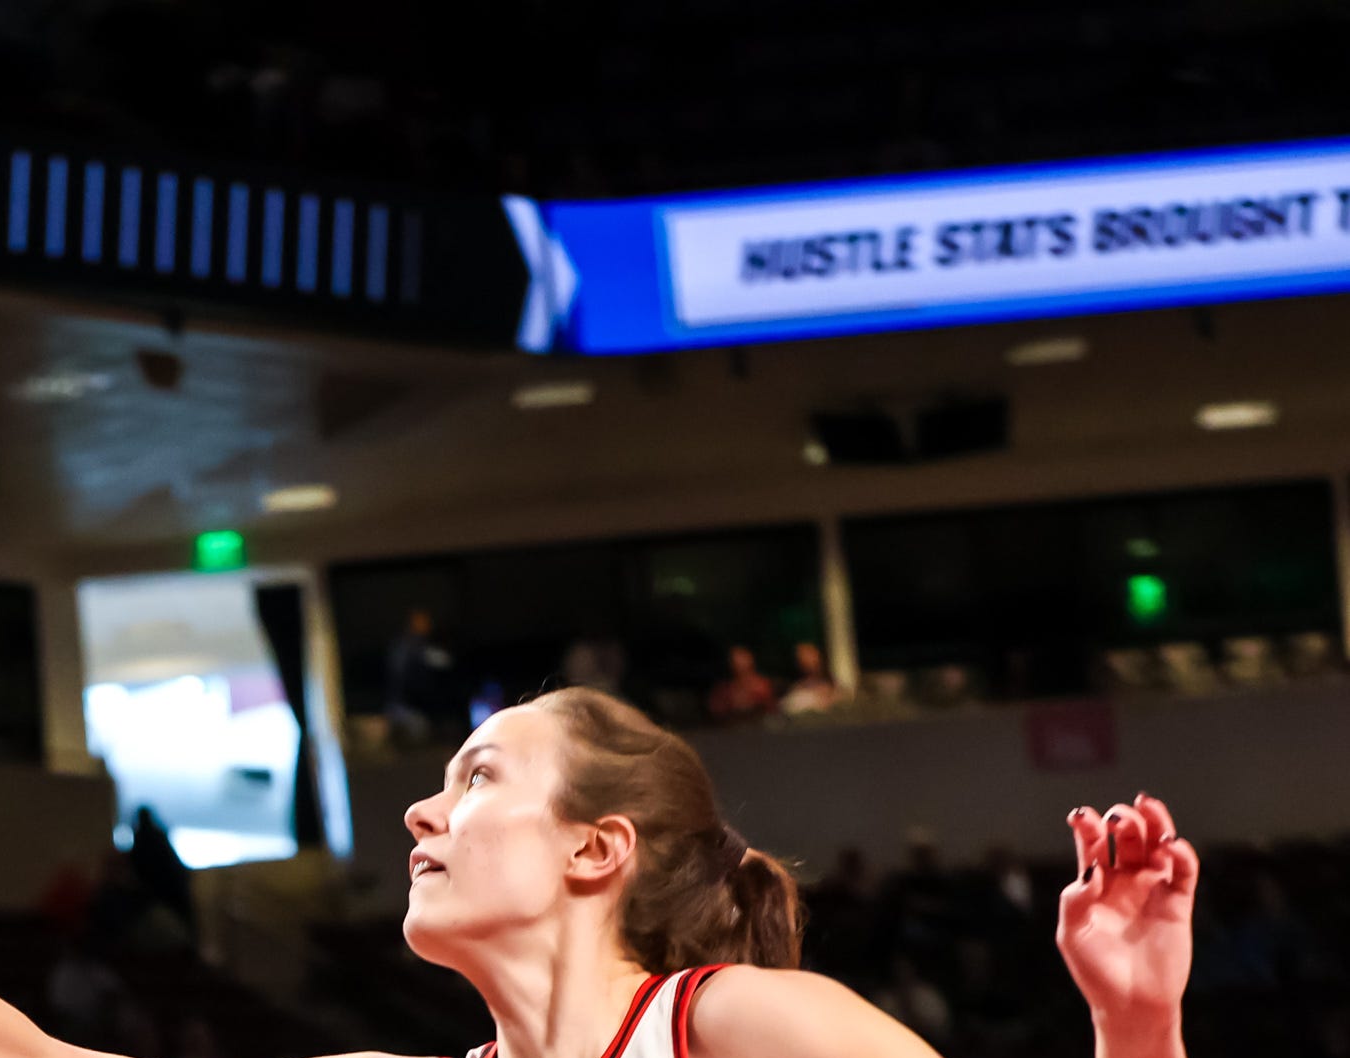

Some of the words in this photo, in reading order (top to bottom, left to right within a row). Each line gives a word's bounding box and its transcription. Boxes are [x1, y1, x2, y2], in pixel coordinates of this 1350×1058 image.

[739, 224, 917, 283] HUSTLE
[936, 213, 1075, 267] STATS
[1093, 192, 1318, 254] BROUGHT
